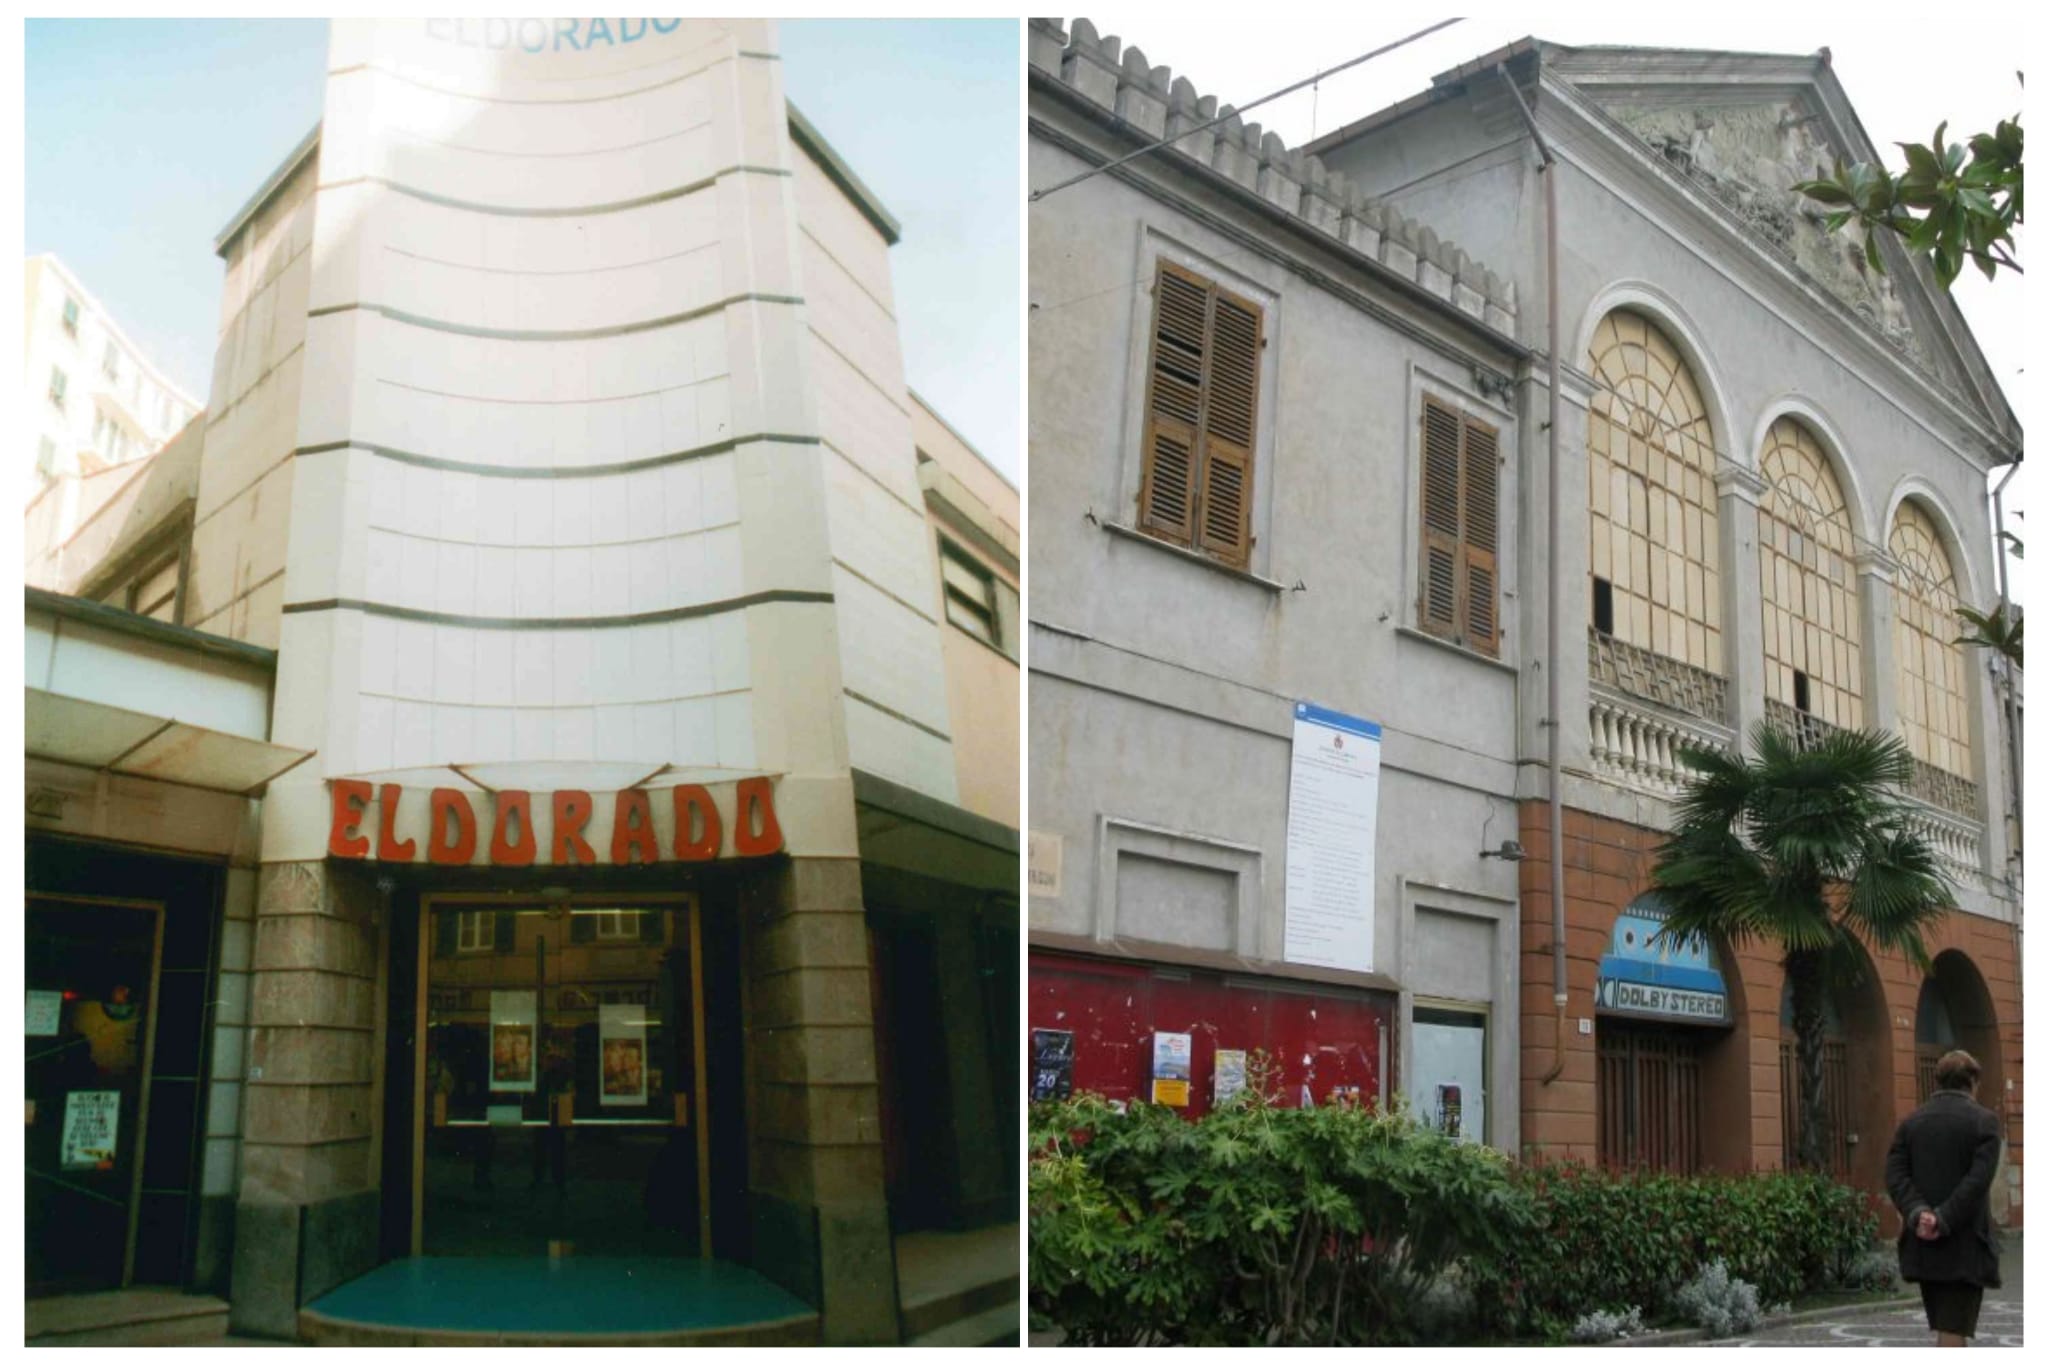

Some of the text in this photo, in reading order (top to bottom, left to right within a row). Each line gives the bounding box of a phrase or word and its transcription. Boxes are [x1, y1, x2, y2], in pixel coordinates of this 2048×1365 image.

[328, 776, 785, 865] ELDORADO
[1619, 986, 1722, 1014] DOLBY STEREO
[1037, 1073, 1056, 1089] 20
